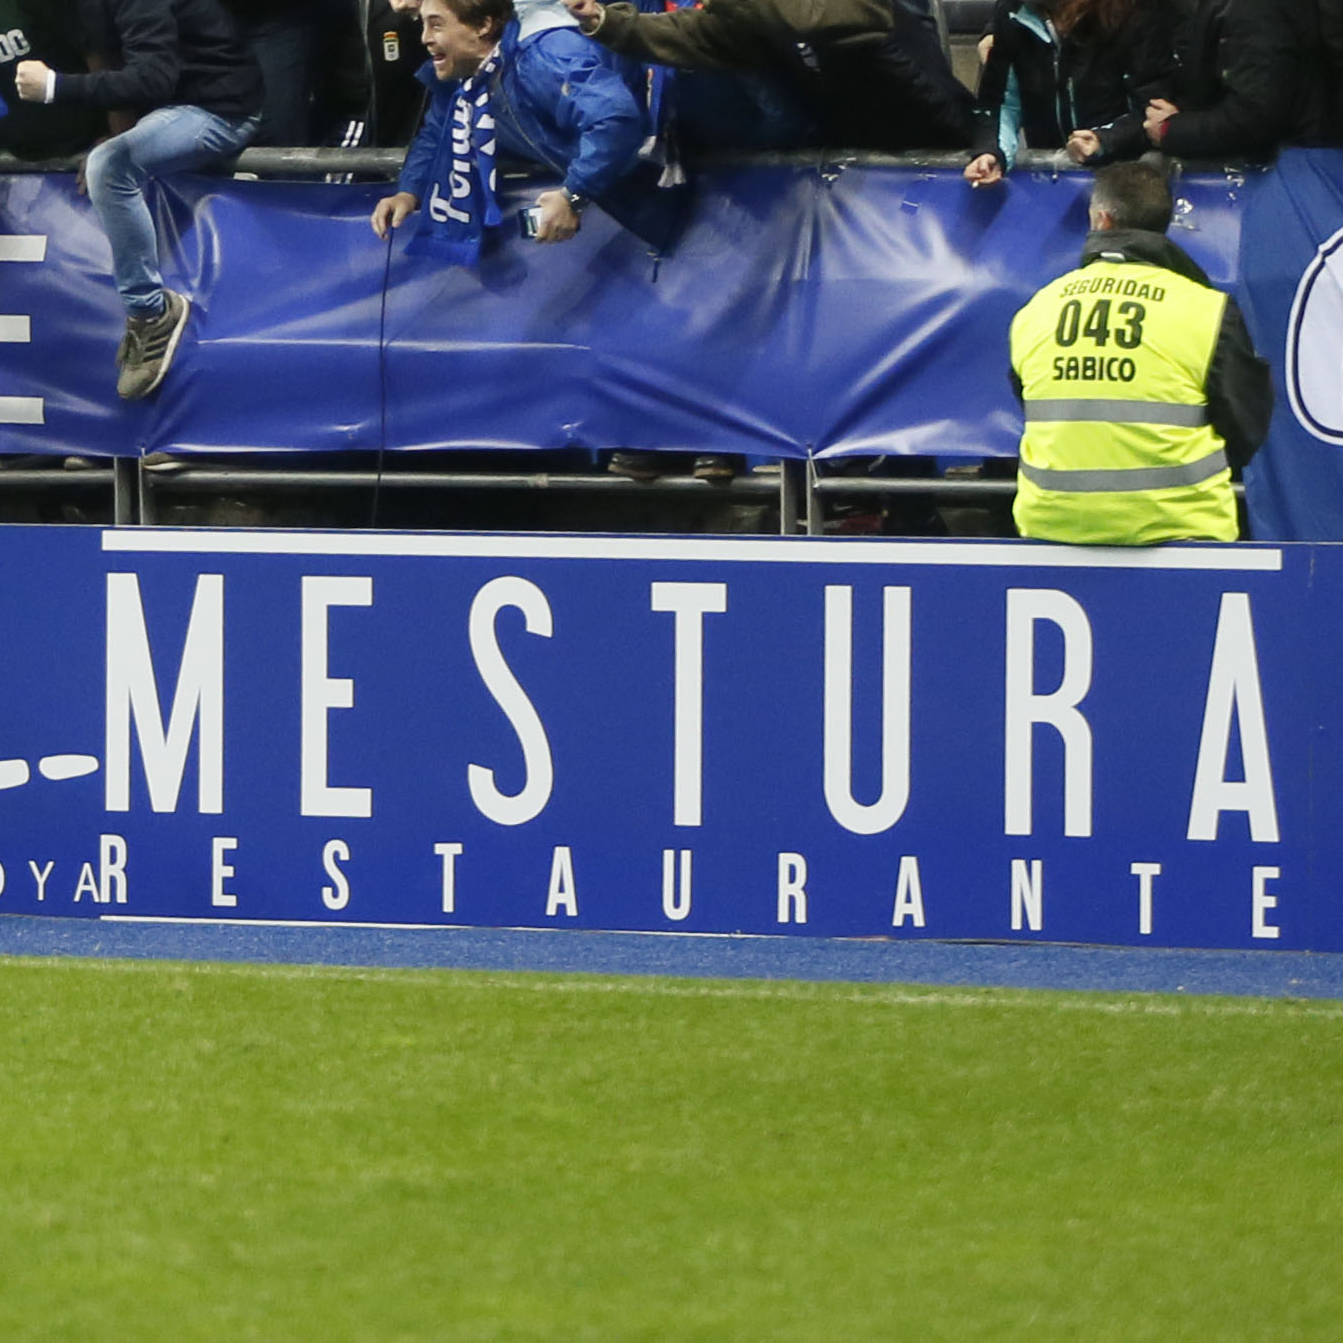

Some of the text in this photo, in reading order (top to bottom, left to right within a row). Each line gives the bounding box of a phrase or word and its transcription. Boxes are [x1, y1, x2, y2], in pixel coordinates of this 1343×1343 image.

[1059, 276, 1166, 303] SEGURIDAD
[1055, 298, 1147, 350] 043
[1052, 355, 1137, 383] SABICO
[104, 572, 1281, 844] MESTURA
[99, 834, 1281, 940] RESTAURANTE
